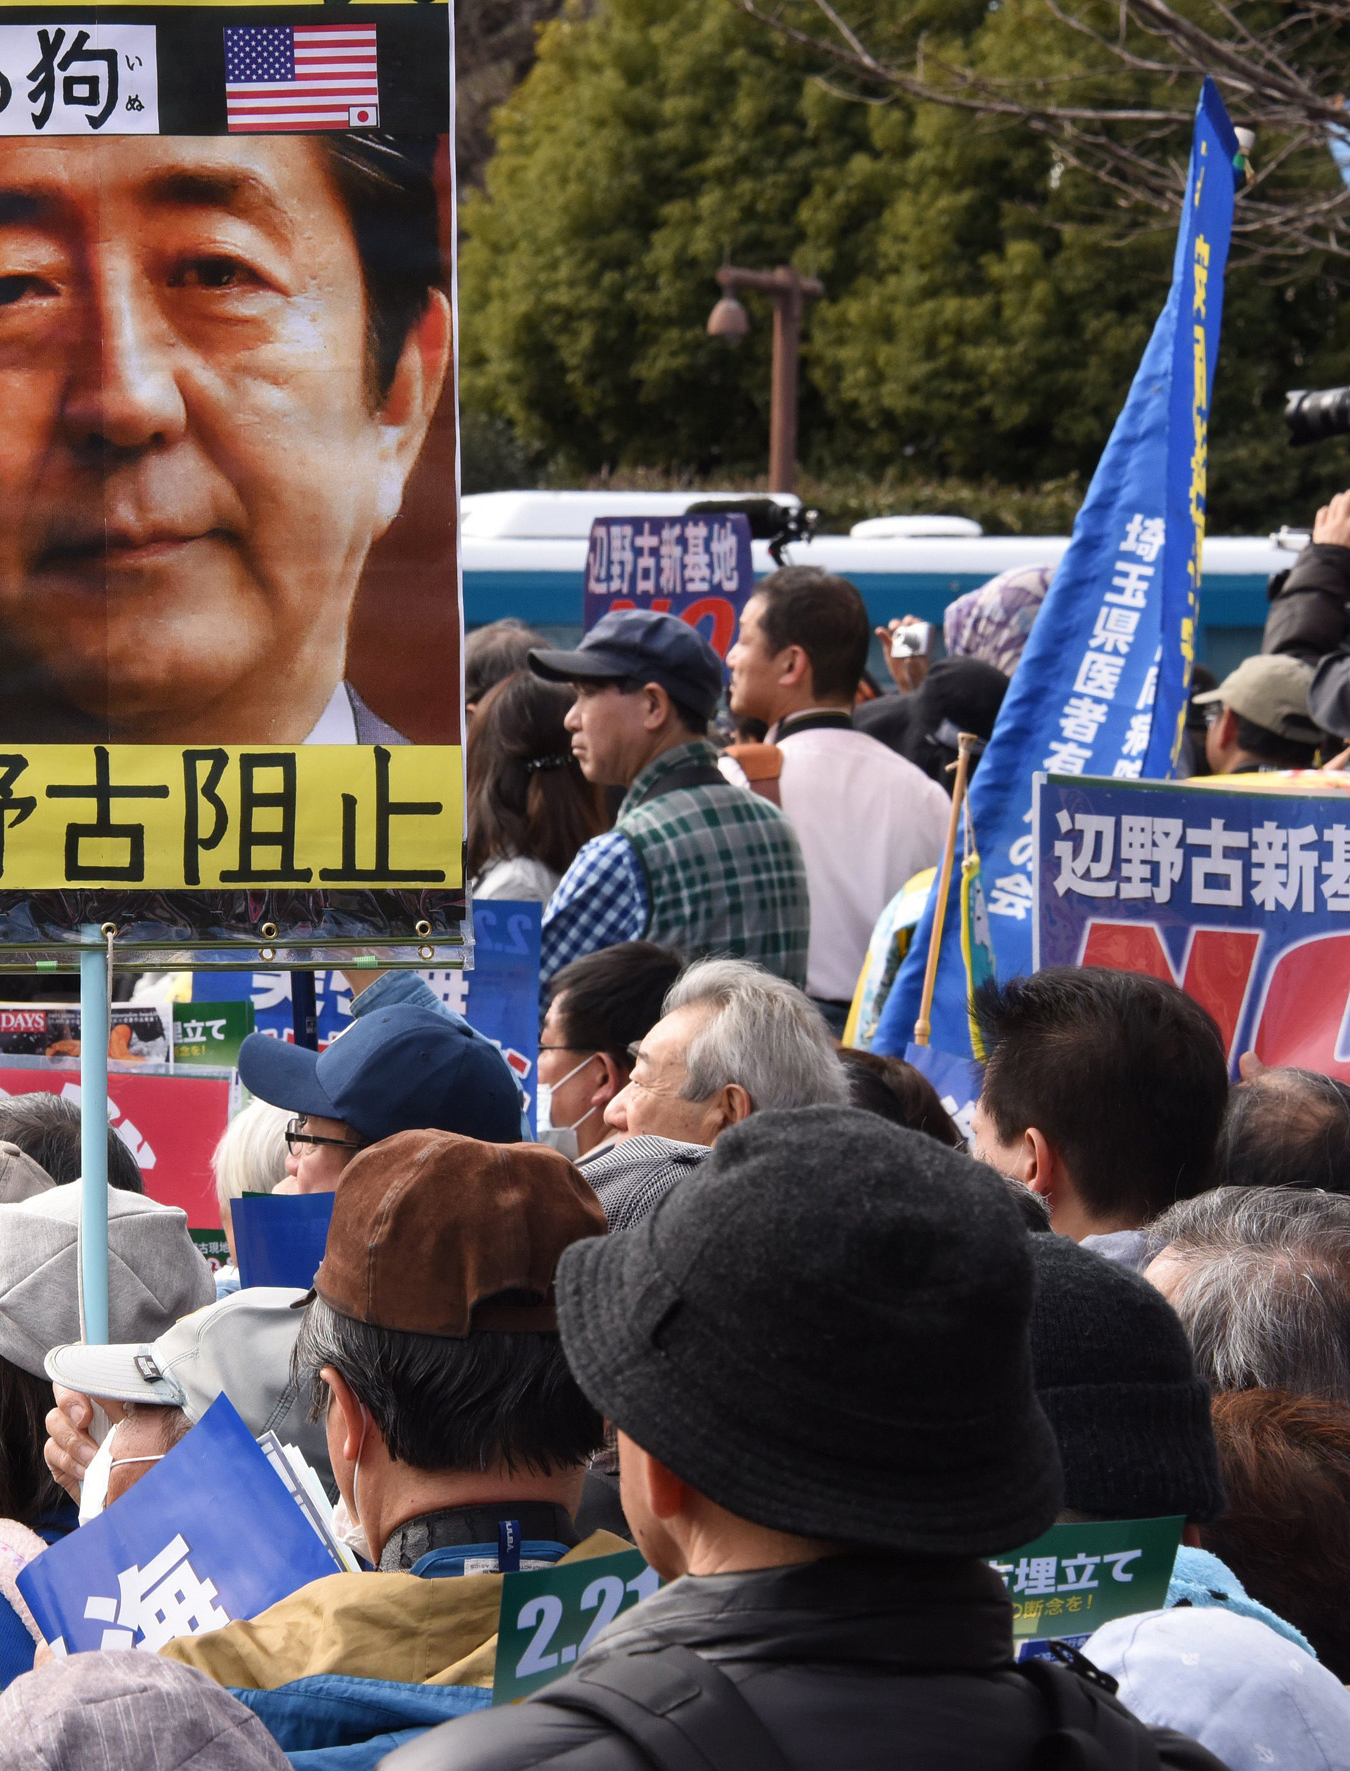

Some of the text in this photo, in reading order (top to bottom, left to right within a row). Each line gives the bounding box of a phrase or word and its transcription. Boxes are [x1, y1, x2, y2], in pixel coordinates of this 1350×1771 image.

[124, 54, 144, 112] いぬ
[587, 520, 740, 595] 辺野古新基地
[0, 1012, 46, 1030] DAYS
